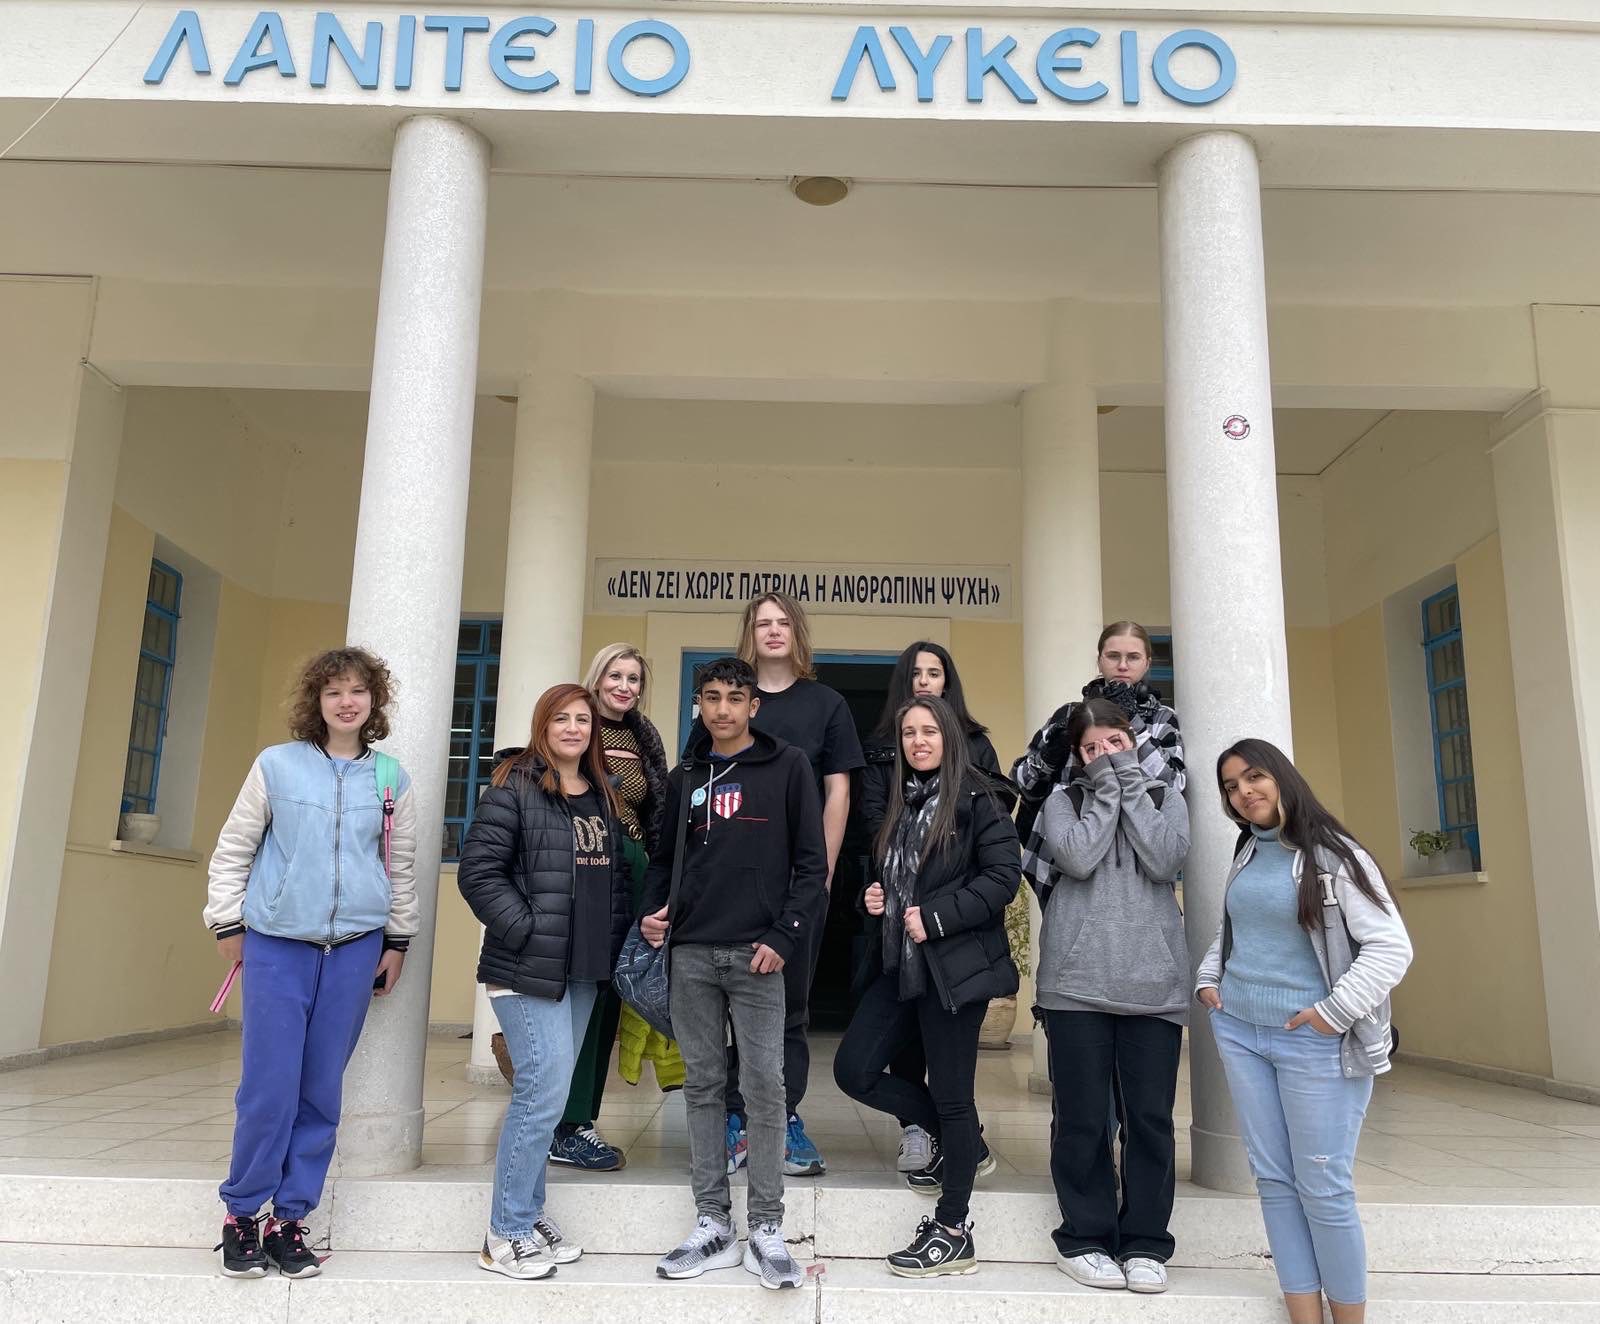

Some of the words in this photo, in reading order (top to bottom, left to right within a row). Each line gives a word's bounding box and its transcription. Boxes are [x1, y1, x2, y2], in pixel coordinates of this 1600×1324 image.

[143, 10, 691, 97] ΛΑΝΙΤΕΙΟ
[831, 26, 1237, 103] ΛΥΚΕΙΟ
[655, 571, 680, 599] ΖΕΙ
[685, 572, 735, 600] ΧΩΡΙΣ
[815, 574, 826, 602] Η
[831, 575, 936, 604] ΑΝΘΡΩΠΙΝΗ
